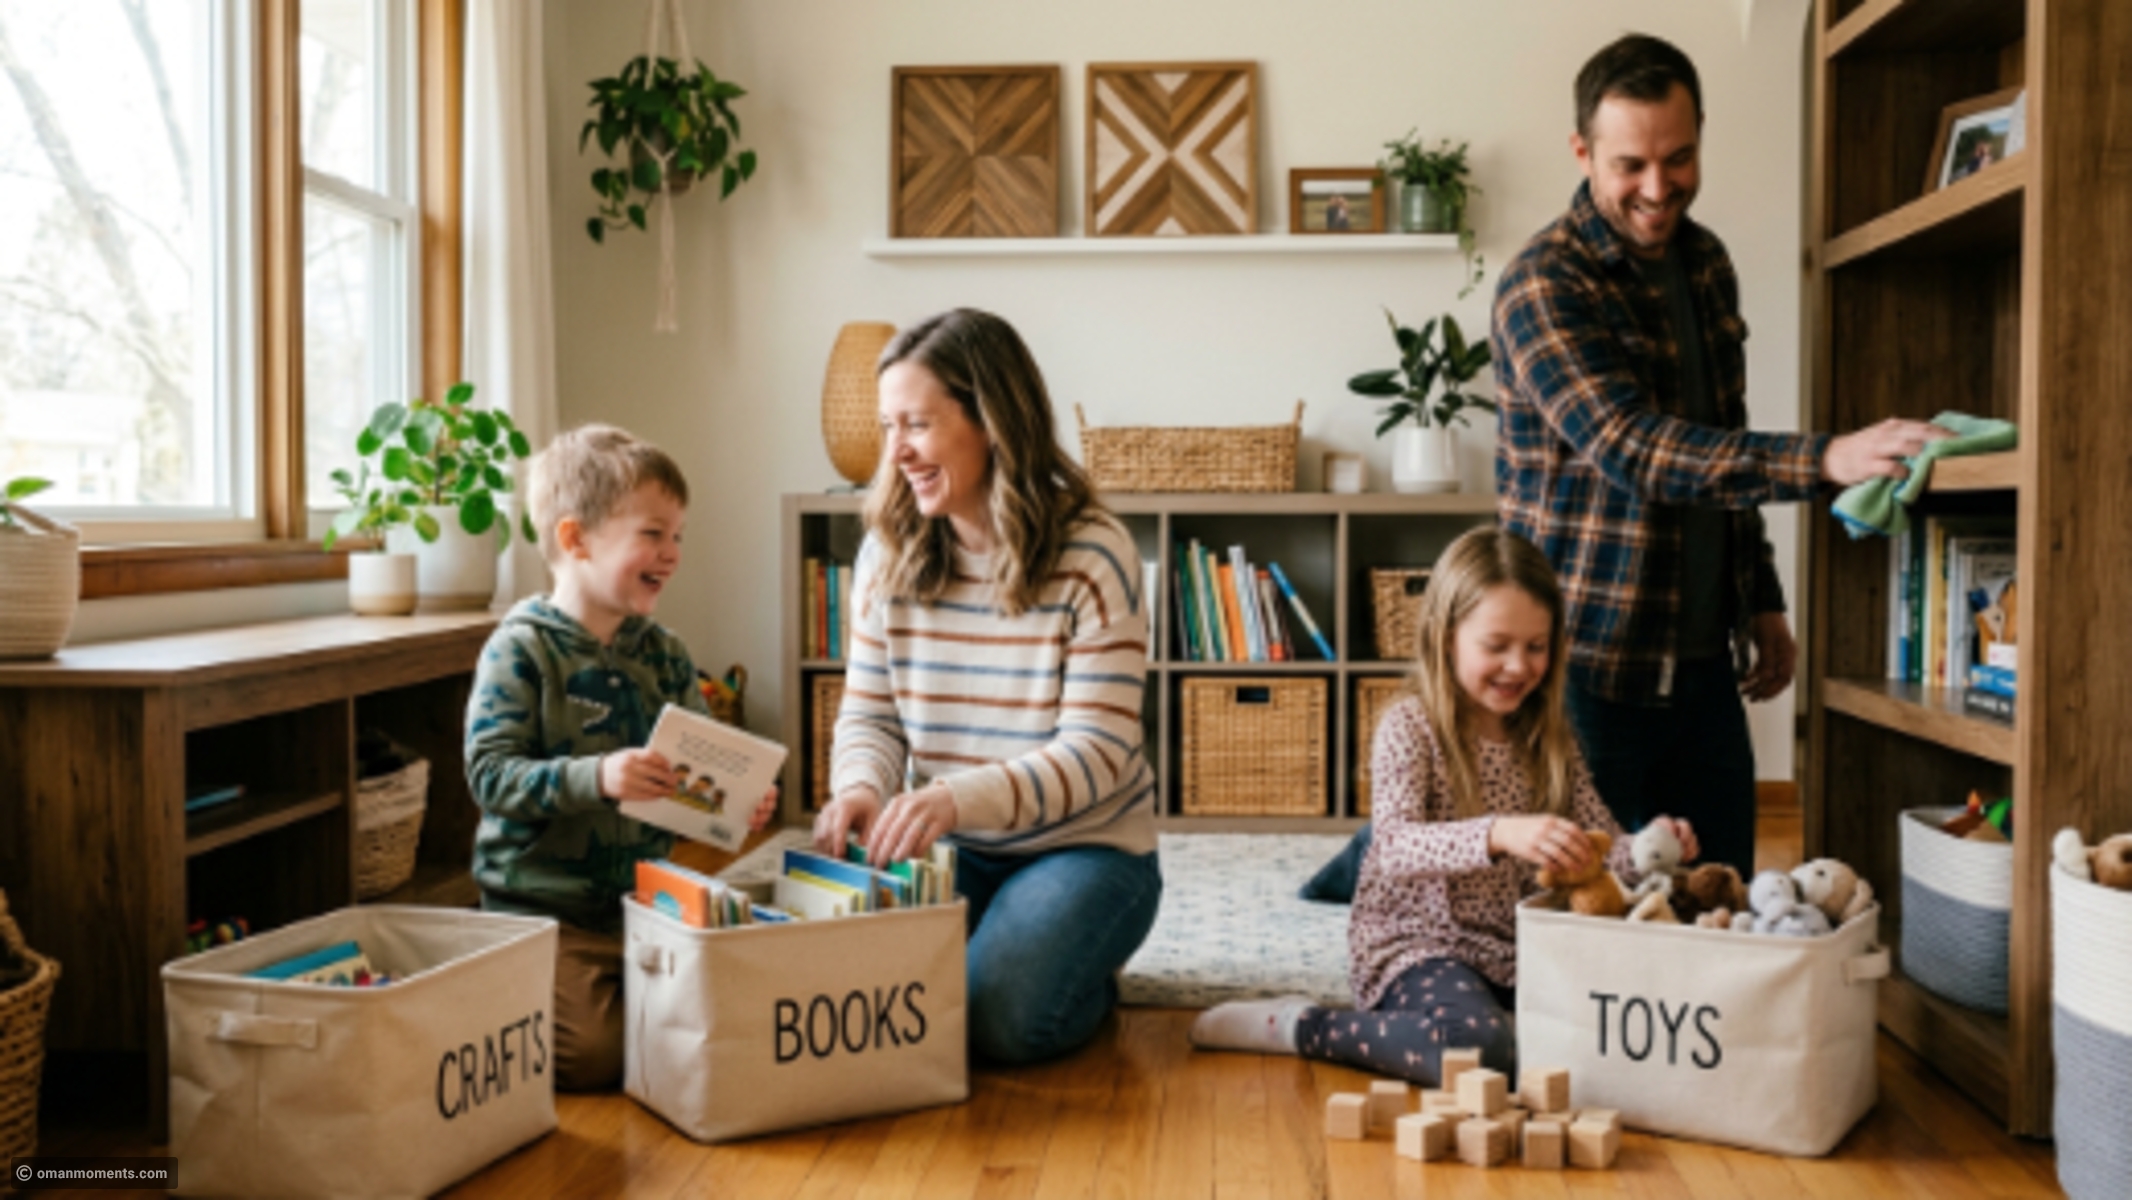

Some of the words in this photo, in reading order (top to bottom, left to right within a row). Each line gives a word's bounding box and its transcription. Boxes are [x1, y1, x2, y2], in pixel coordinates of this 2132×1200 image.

[436, 1010, 546, 1120] CRAFTS
[774, 981, 927, 1065] BOOKS
[1588, 990, 1723, 1069] TOYS
